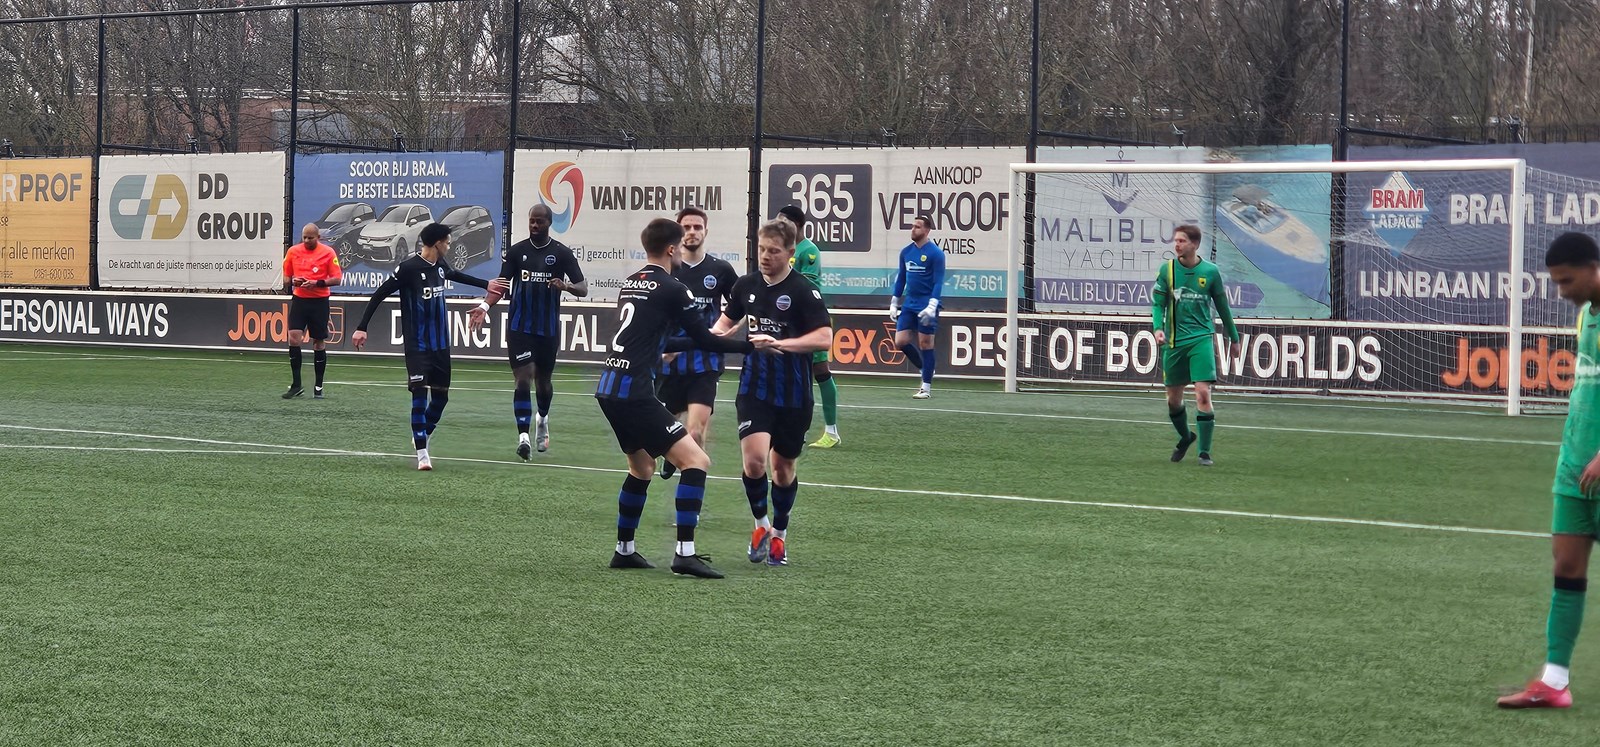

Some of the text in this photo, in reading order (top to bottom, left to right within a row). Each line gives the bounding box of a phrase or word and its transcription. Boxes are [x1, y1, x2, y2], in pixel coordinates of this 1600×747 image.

[349, 160, 449, 177] SCOOR BIJ BRAM.
[913, 166, 983, 185] AANKOOP
[198, 173, 229, 200] DD
[339, 182, 455, 199] DE BESTE LEASEDEAL
[590, 185, 722, 211] VAN DER HELM
[786, 173, 854, 219] 365
[1372, 189, 1424, 209] BRAM
[197, 211, 273, 240] GROUP
[803, 220, 854, 243] ONEN
[1041, 217, 1199, 244] MALIBLU
[9, 240, 29, 260] alle
[32, 240, 75, 260] merken
[587, 247, 625, 262] gezocht!
[108, 259, 273, 272] De kracht van de juiste mensen op de juiste plek!
[952, 273, 977, 291] 745
[980, 274, 1004, 292] 061
[1359, 270, 1491, 299] LIJNBAAN
[105, 302, 169, 338] WAYS
[611, 302, 636, 353] 2
[1049, 327, 1096, 371] OF
[1106, 330, 1157, 374] BO
[1215, 332, 1383, 382] WORLDS
